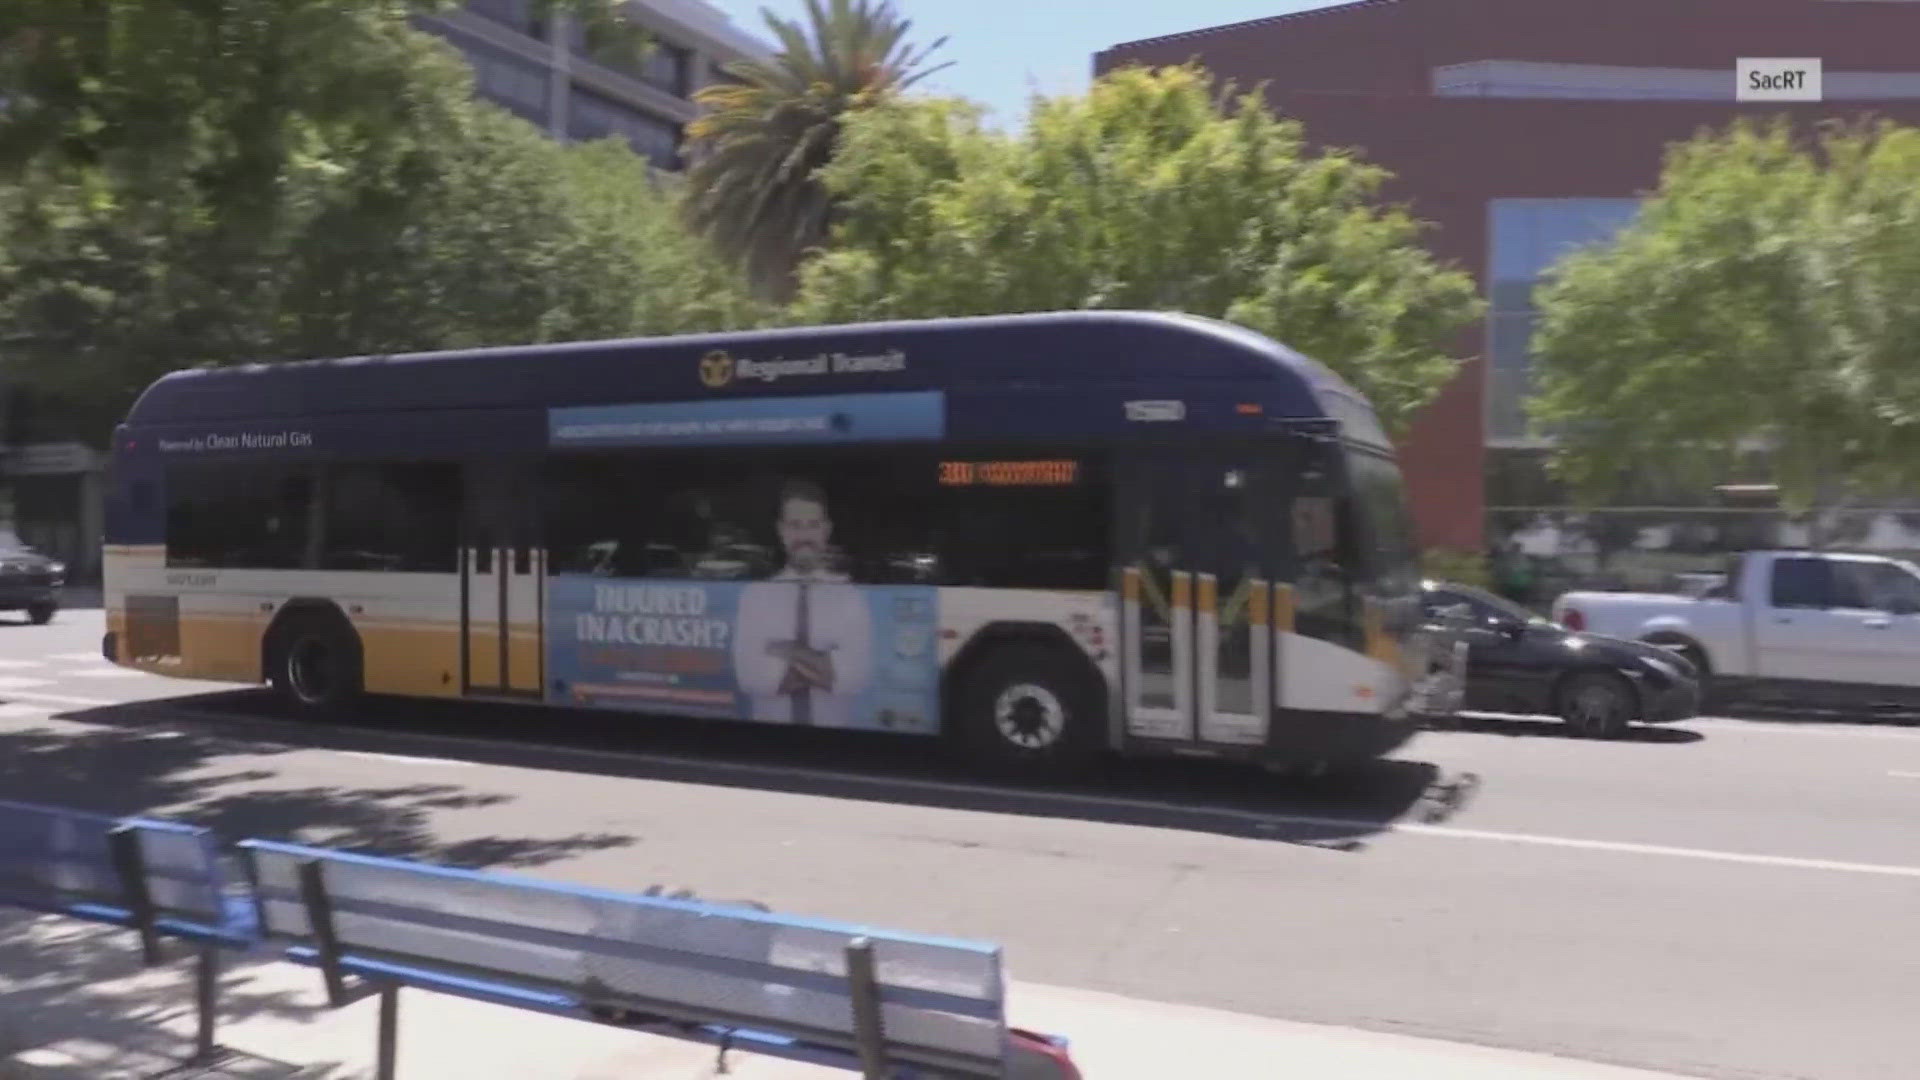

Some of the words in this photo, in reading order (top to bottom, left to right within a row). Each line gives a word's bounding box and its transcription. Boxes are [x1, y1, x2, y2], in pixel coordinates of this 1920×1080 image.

[736, 352, 828, 382] Regional
[831, 348, 906, 373] Transit
[207, 432, 239, 449] Clean
[241, 431, 287, 449] Natural
[289, 430, 313, 447] Gas
[594, 582, 707, 616] INJURED
